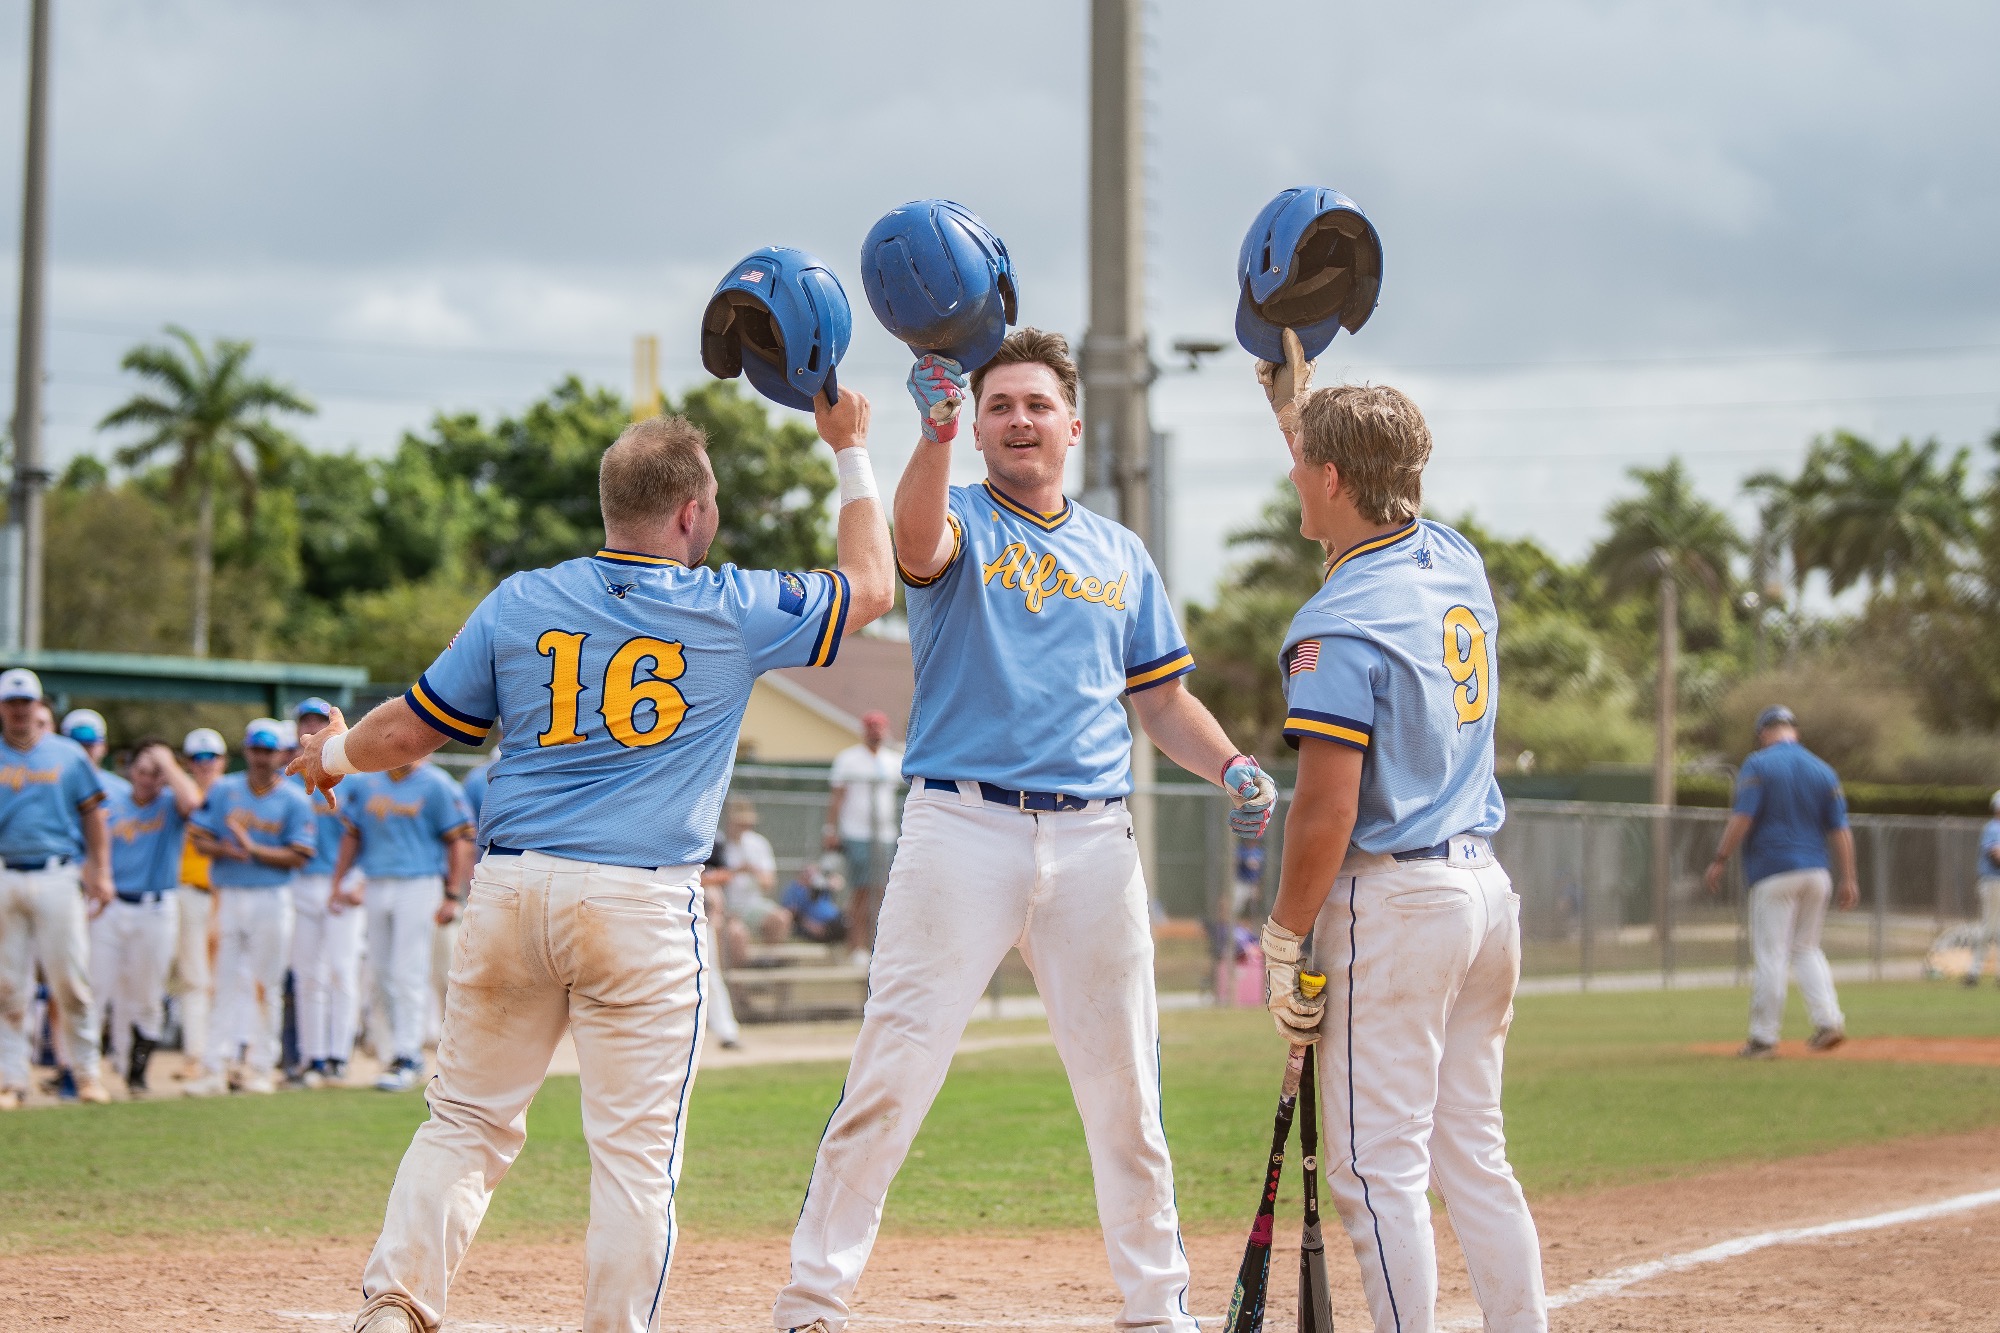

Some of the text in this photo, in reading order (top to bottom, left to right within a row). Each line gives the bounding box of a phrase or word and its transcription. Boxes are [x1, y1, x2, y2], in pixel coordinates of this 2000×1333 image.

[982, 541, 1129, 613] Alfred
[536, 628, 695, 748] 16
[1442, 604, 1489, 733] 9
